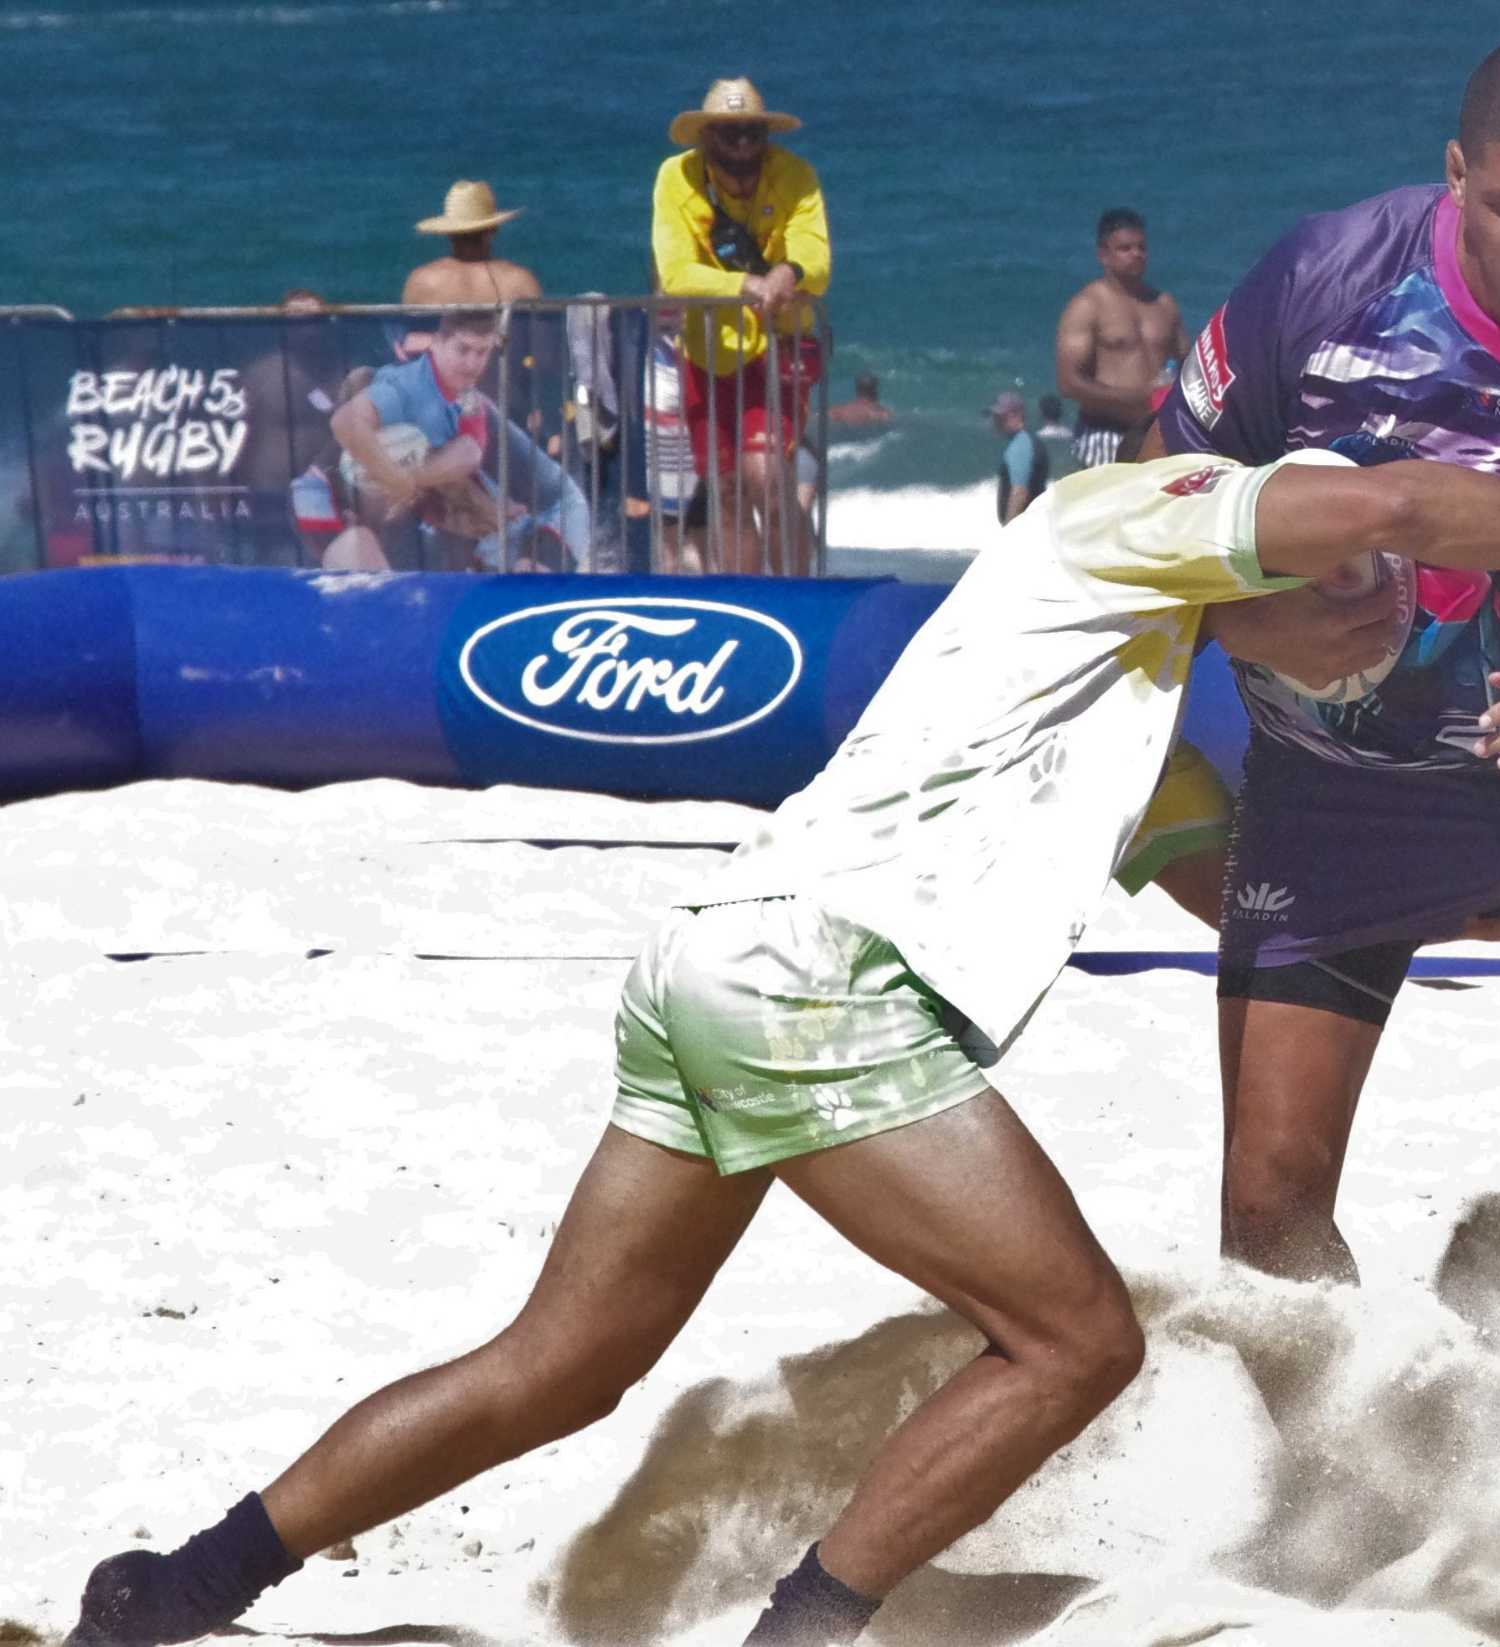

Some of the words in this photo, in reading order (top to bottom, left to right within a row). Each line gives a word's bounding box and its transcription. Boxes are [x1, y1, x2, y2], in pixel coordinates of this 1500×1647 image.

[66, 363, 204, 419] BEACH
[67, 415, 248, 481] RUGBY
[75, 501, 250, 520] AUSTRALIA
[520, 610, 739, 715] Ford
